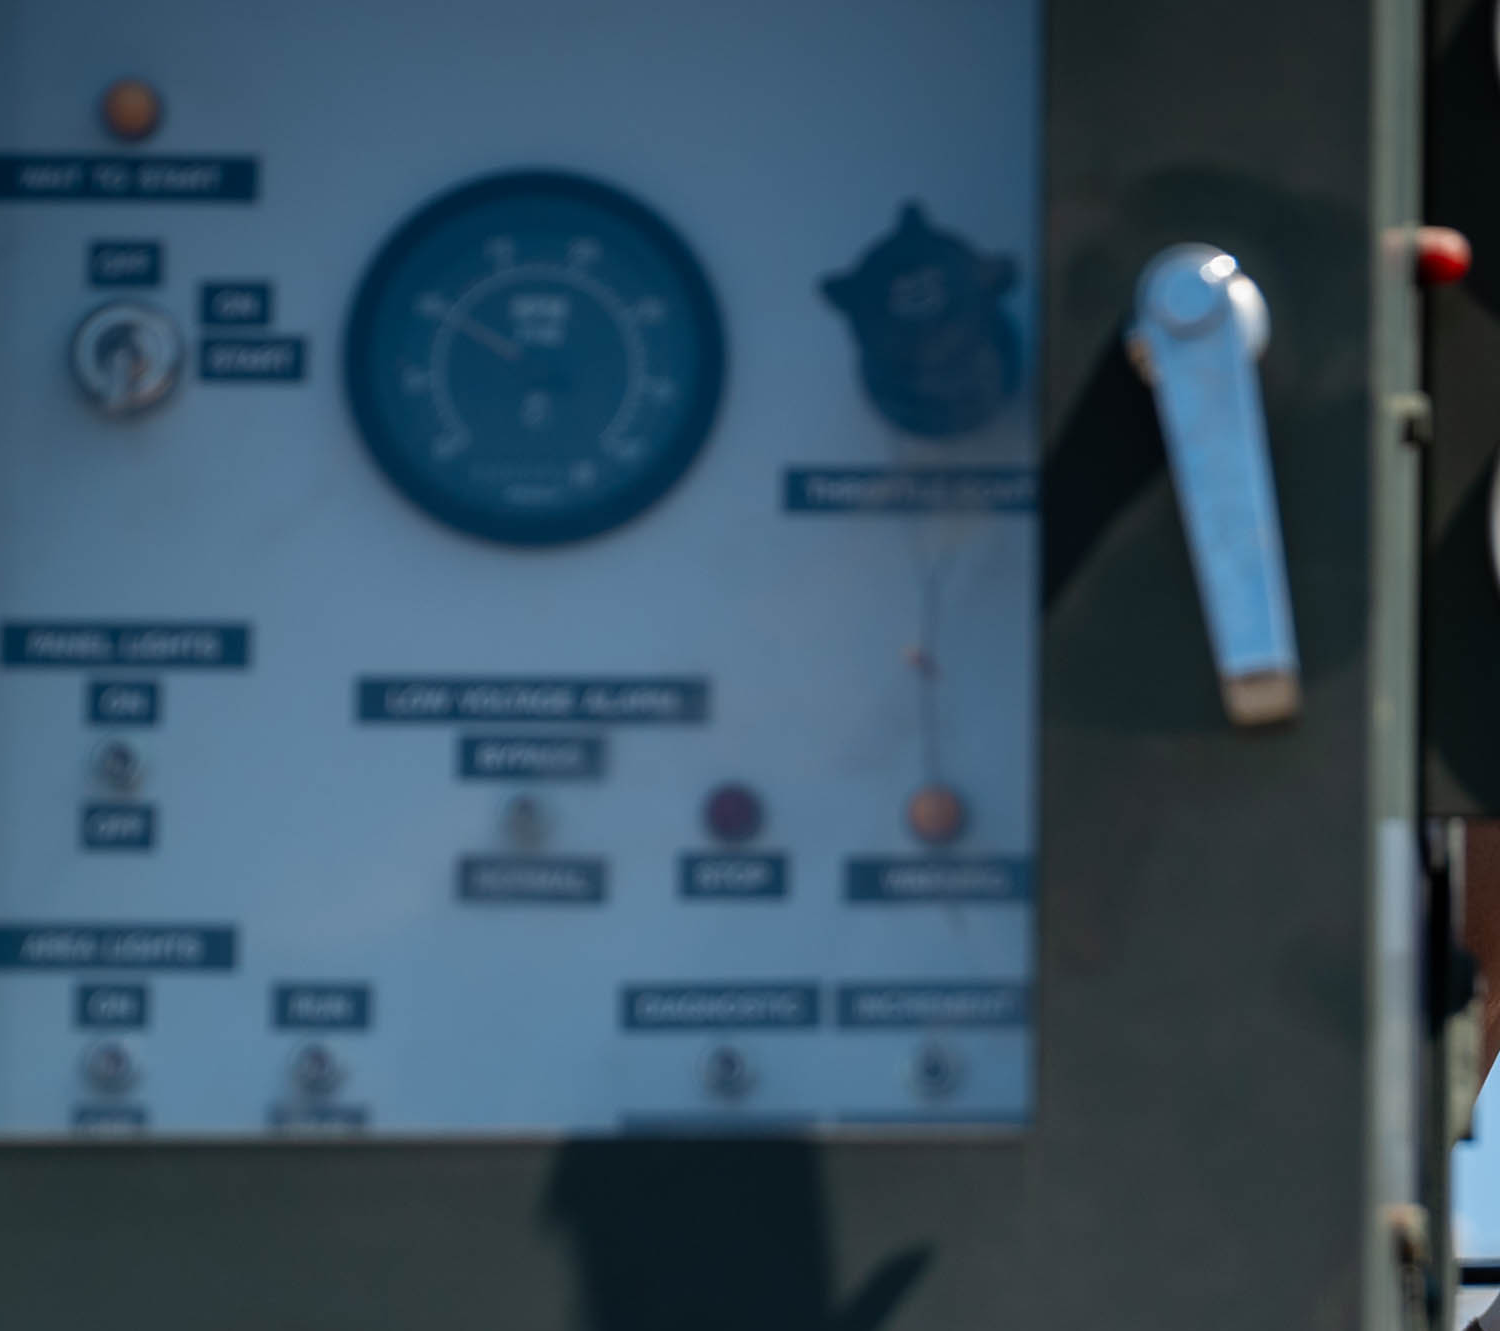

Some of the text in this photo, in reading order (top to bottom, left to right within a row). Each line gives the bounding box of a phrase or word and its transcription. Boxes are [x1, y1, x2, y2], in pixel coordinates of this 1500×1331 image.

[92, 164, 130, 191] TO
[137, 165, 223, 192] START
[97, 251, 152, 278] OFF
[212, 292, 259, 318] ON
[208, 346, 294, 372] START
[26, 634, 221, 659] PANEL LIGHTS
[102, 689, 148, 714] ON
[388, 687, 680, 715] LOW VOLTAGE ALARM
[474, 745, 587, 771] BYPASS
[90, 815, 143, 840] OFF
[695, 864, 772, 890] STOP
[22, 935, 203, 962] AREA LIGHTS
[91, 992, 136, 1018] ON
[635, 993, 806, 1020] DIAGNOSTIC
